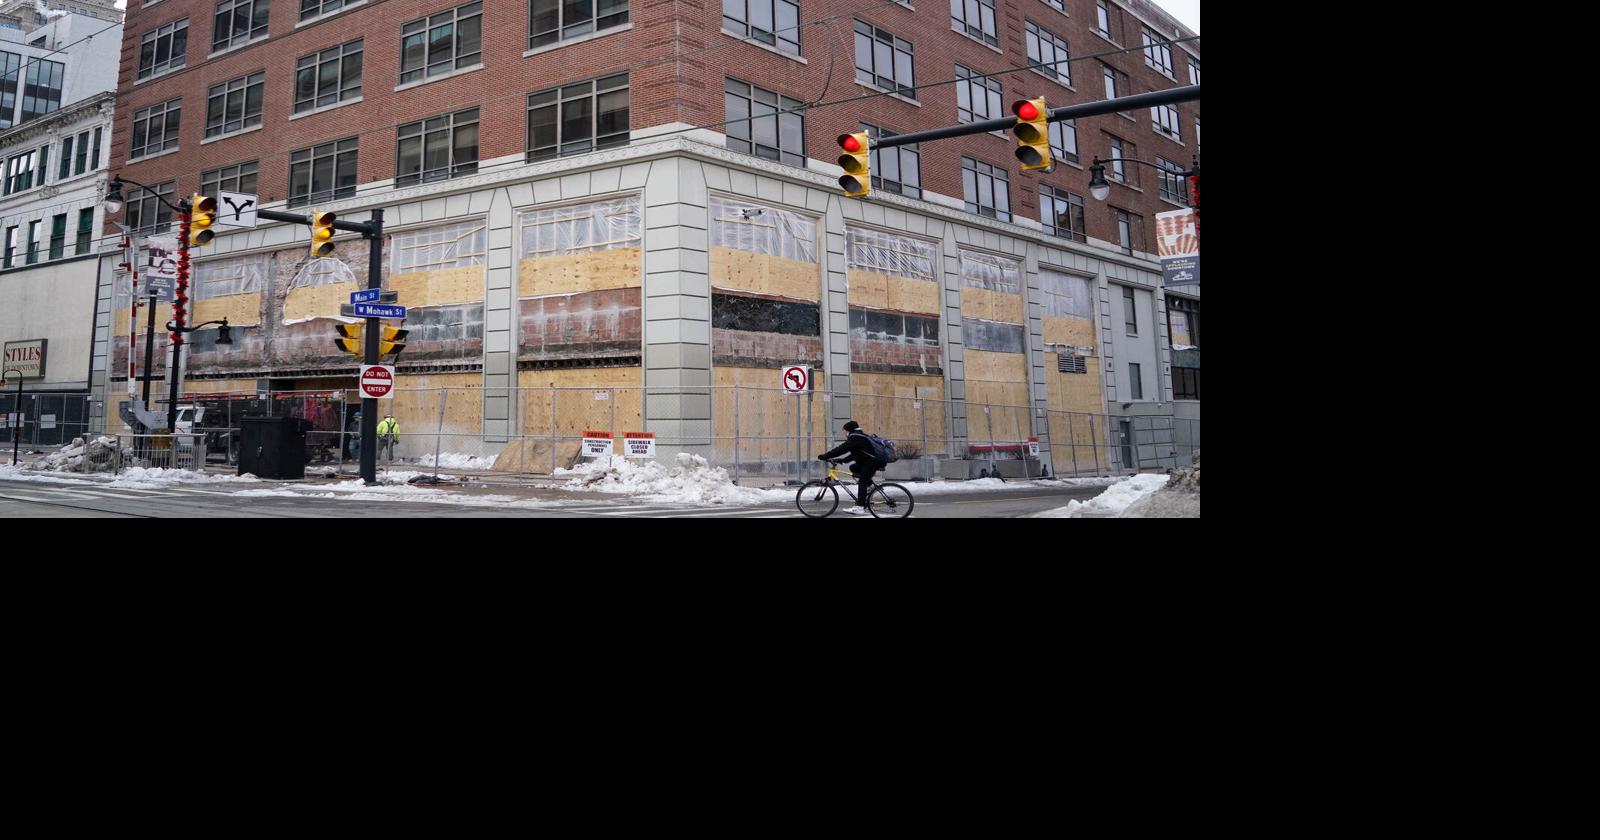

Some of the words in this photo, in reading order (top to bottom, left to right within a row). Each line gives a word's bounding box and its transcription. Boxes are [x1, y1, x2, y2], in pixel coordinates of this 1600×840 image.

[355, 293, 367, 302] Main
[366, 305, 393, 316] Mohawk
[5, 347, 41, 362] STYLES
